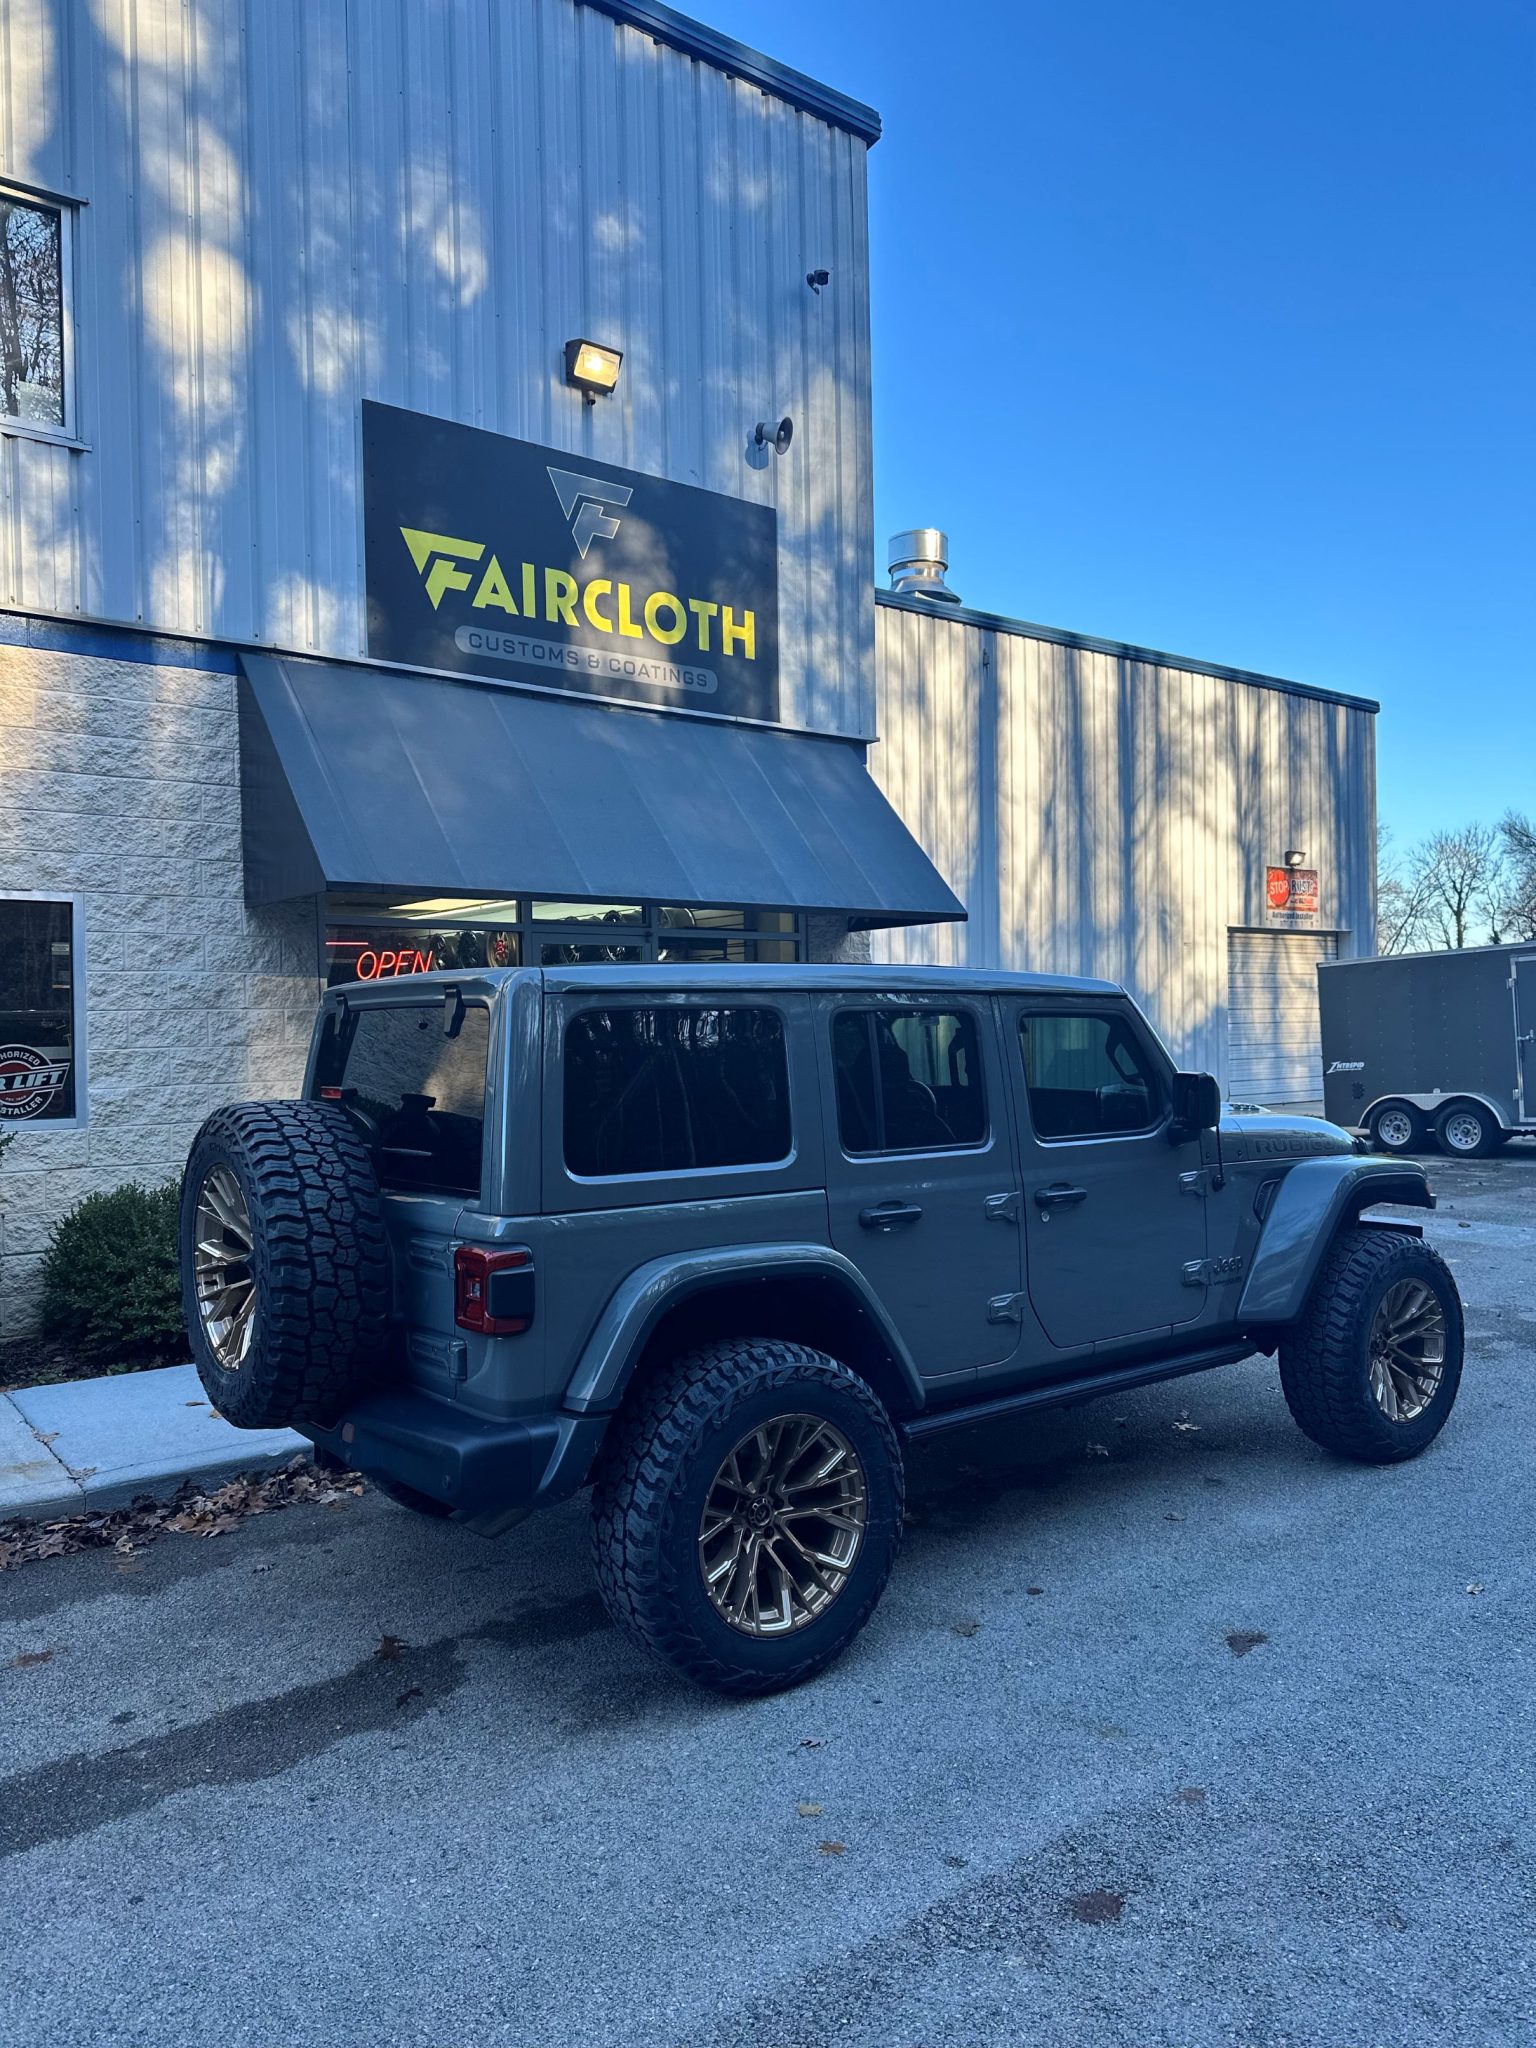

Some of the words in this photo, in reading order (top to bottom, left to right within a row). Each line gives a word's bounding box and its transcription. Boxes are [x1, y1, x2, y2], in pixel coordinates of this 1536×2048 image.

[400, 527, 756, 660] FAIRCLOTH
[468, 632, 580, 666] CUSTOMS
[587, 654, 601, 669] &
[608, 657, 708, 688] COATINGS
[1269, 880, 1289, 895] STOP
[356, 951, 433, 980] OPEN
[12, 1070, 63, 1089] LIFT
